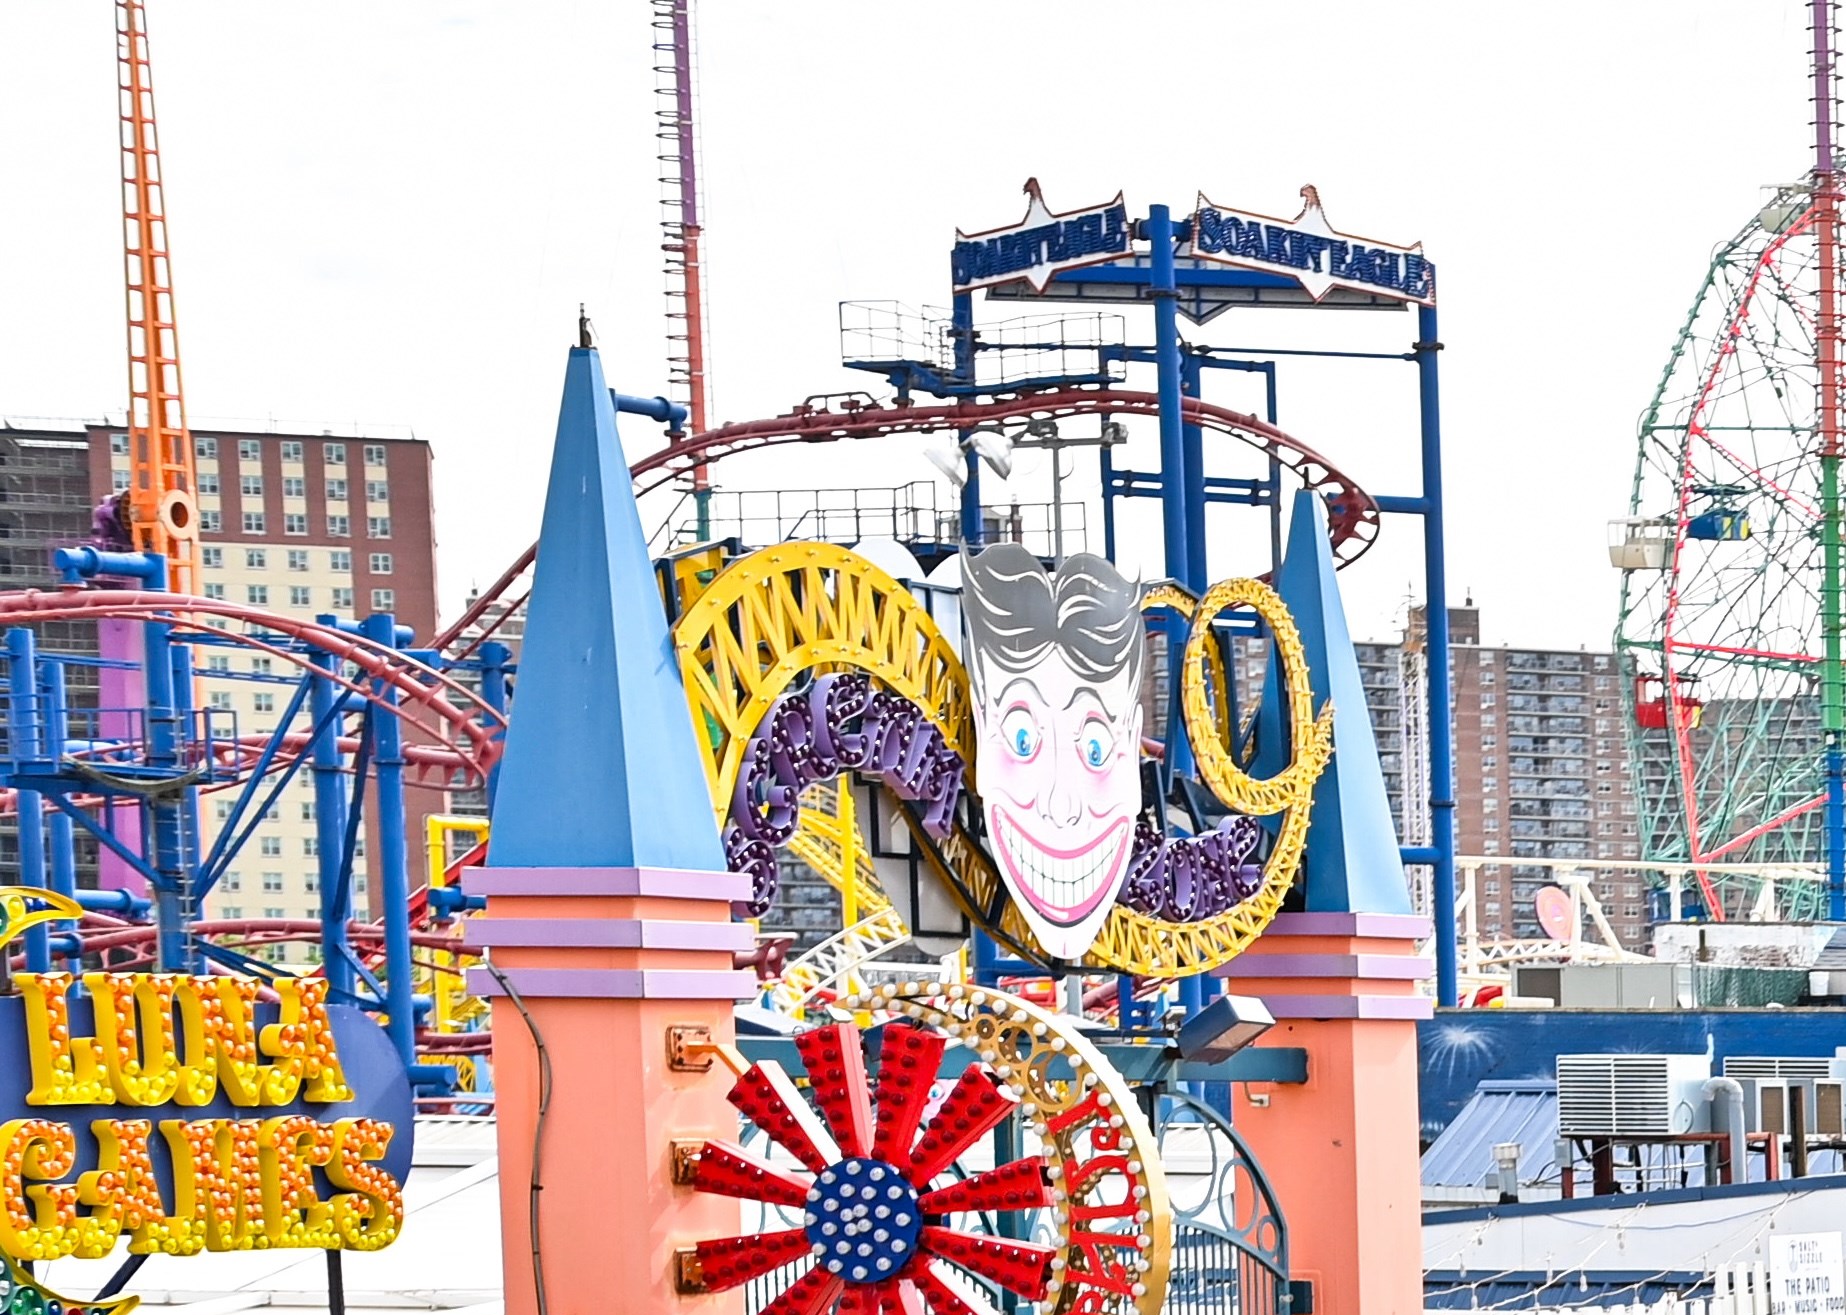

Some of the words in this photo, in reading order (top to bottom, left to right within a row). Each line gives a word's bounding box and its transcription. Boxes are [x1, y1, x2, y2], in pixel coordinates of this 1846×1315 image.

[14, 972, 353, 1106] LUNA
[0, 1117, 403, 1260] GAMES
[1772, 1301, 1786, 1315] BAR
[1795, 1299, 1818, 1314] MUSIC
[1826, 1296, 1845, 1312] FOOD
[1785, 1278, 1802, 1297] THE
[1806, 1276, 1830, 1295] PATIO
